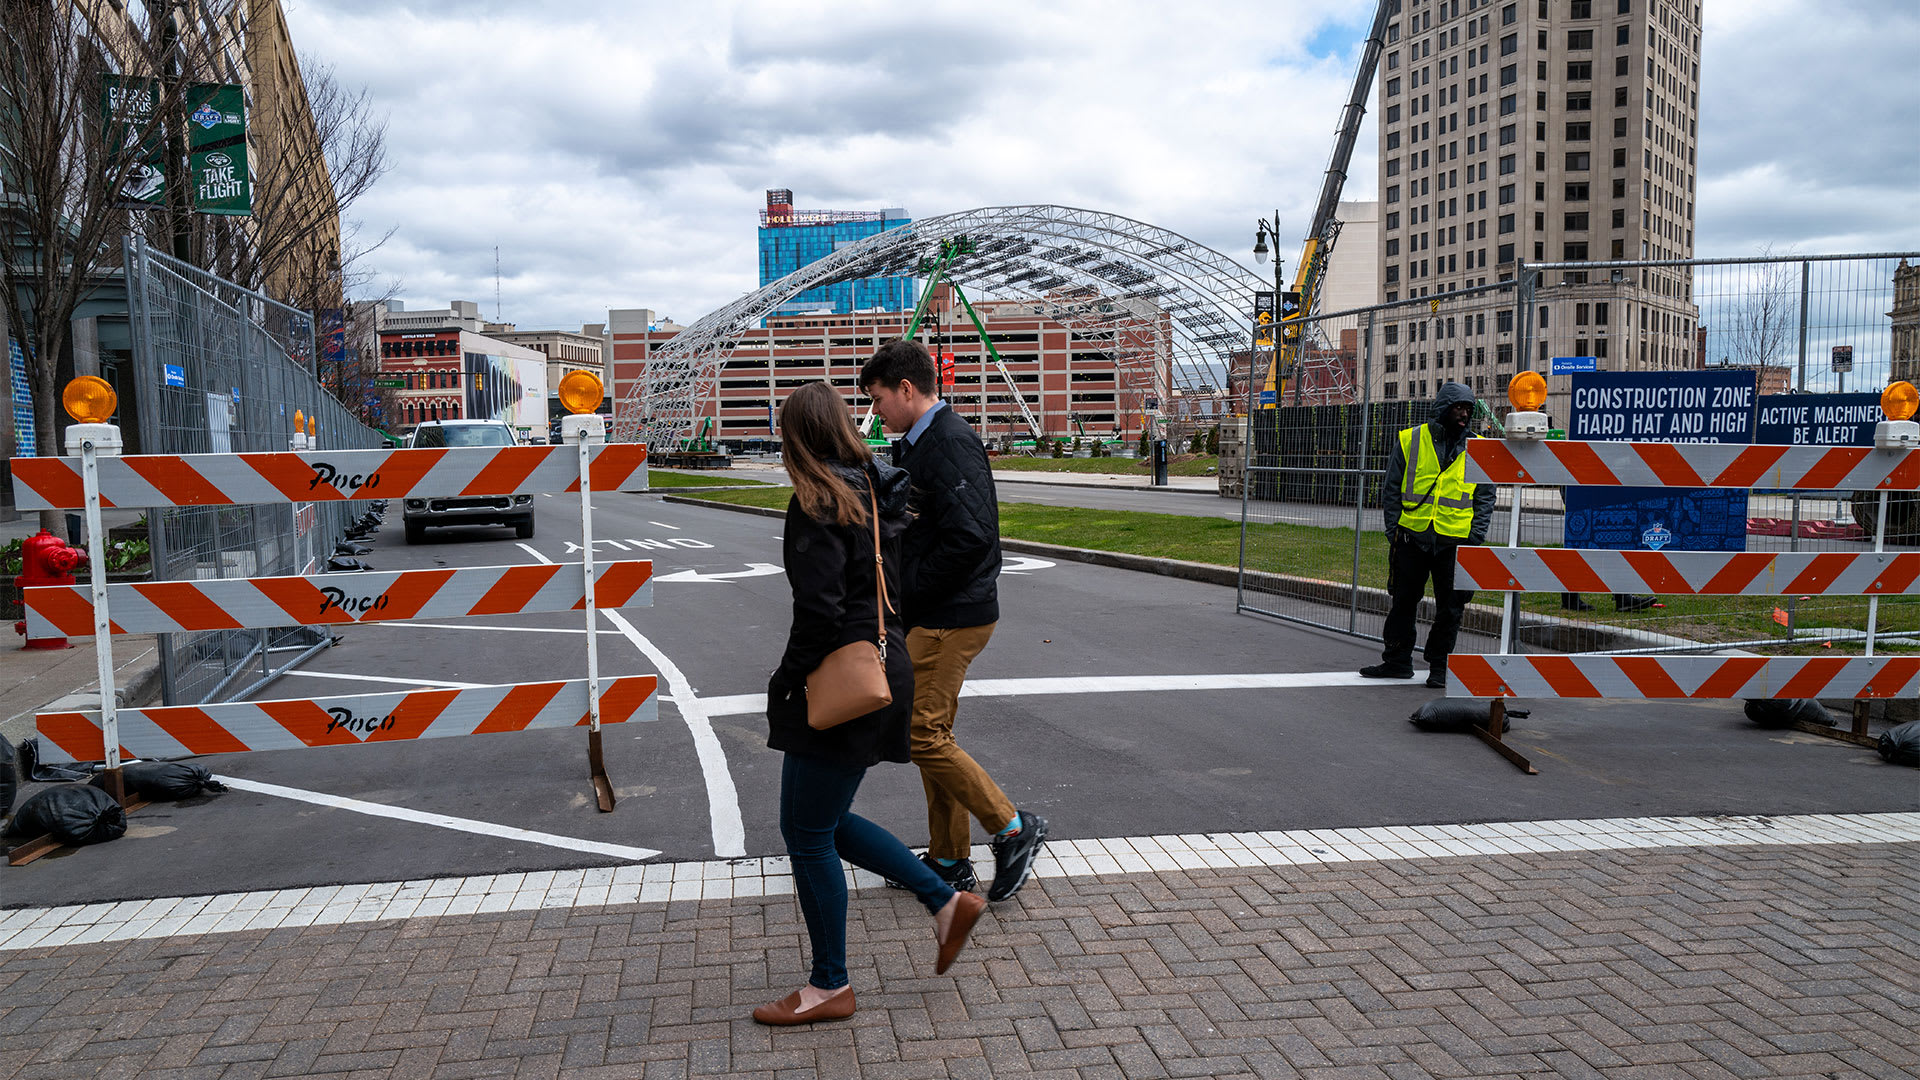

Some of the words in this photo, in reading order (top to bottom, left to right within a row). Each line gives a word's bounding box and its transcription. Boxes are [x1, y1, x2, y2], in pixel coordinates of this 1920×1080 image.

[203, 166, 235, 184] TAKE
[200, 180, 243, 200] FLIGHT
[766, 214, 828, 223] HOLLYWOOD
[1575, 387, 1707, 410] CONSTRUCTION
[1711, 386, 1753, 408] ZONE
[1577, 413, 1626, 435] HARD
[1631, 413, 1665, 434] HAT
[1669, 412, 1704, 434] AND
[1709, 412, 1748, 433] HIGH
[1760, 407, 1809, 425] ACTIVE
[1793, 427, 1810, 444] BE
[1815, 426, 1858, 443] ALERT
